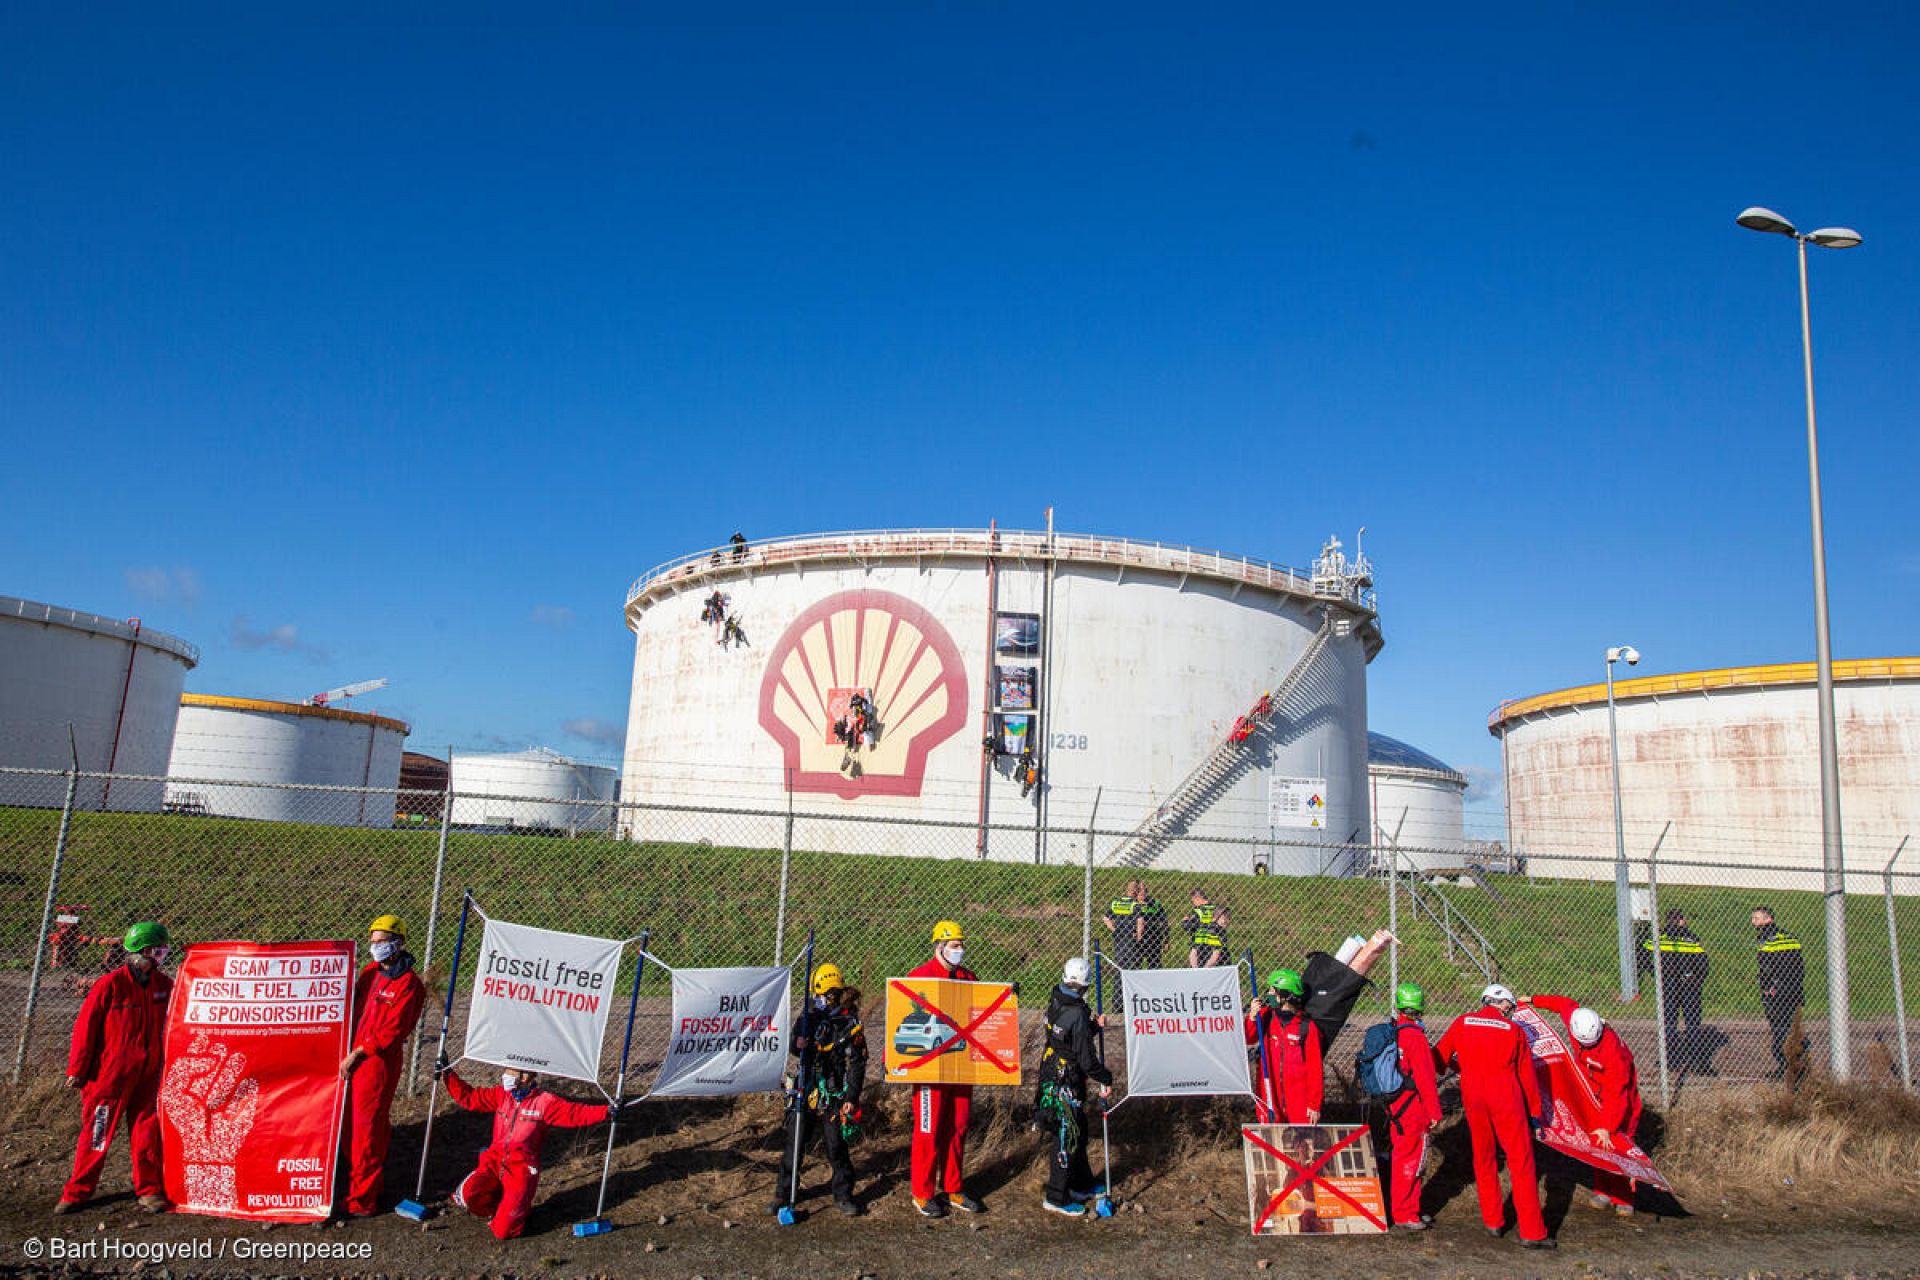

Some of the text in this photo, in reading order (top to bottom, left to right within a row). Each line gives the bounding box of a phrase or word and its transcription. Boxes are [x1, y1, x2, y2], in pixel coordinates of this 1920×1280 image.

[229, 958, 344, 976] SCAN TO BAN
[486, 950, 604, 990] fossil free
[194, 980, 342, 999] FOSSIL FUEL ADS
[719, 994, 750, 1012] BAN
[1131, 991, 1233, 1017] fossil free
[189, 1003, 340, 1023] & SPONSORSHIPS
[681, 1015, 737, 1035] FOSSIL
[674, 1036, 779, 1055] ADVERTISING
[277, 1157, 324, 1174] FOSSIL
[290, 1175, 323, 1191] FREE
[247, 1193, 323, 1208] REVOLUTION
